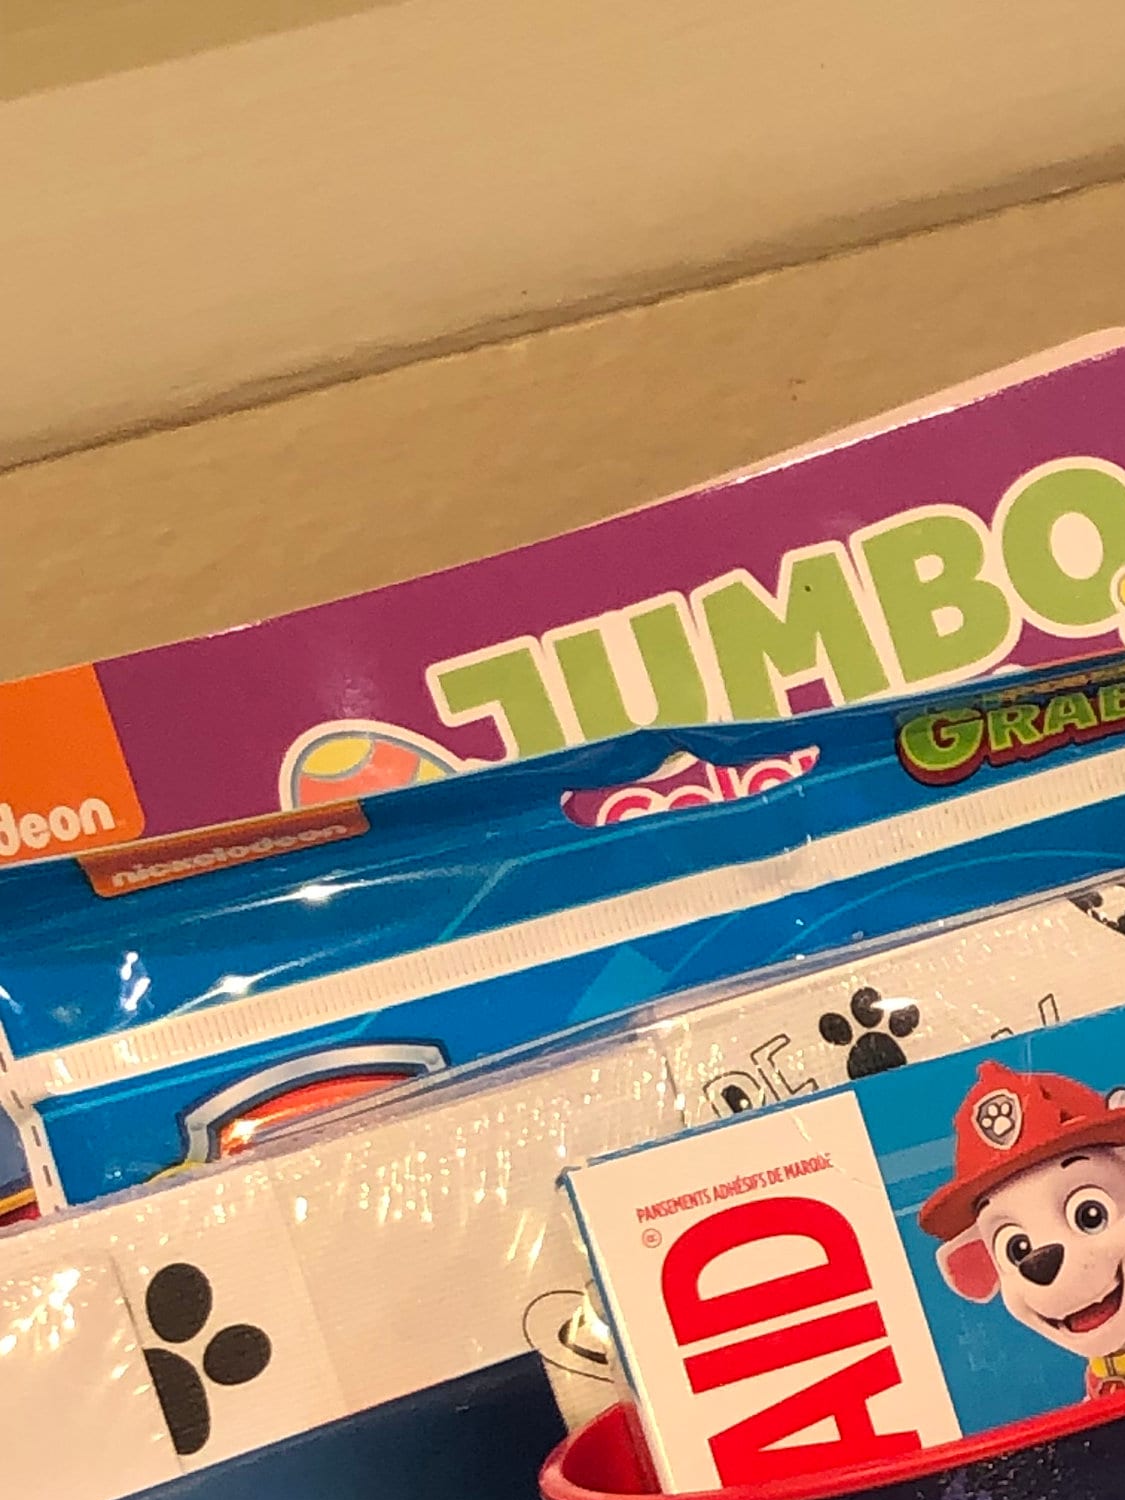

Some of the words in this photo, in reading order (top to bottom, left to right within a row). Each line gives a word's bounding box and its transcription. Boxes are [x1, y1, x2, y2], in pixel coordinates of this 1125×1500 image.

[636, 1188, 711, 1223] PANSEMENTS
[766, 1165, 785, 1186] DE
[661, 1195, 922, 1488] AID
